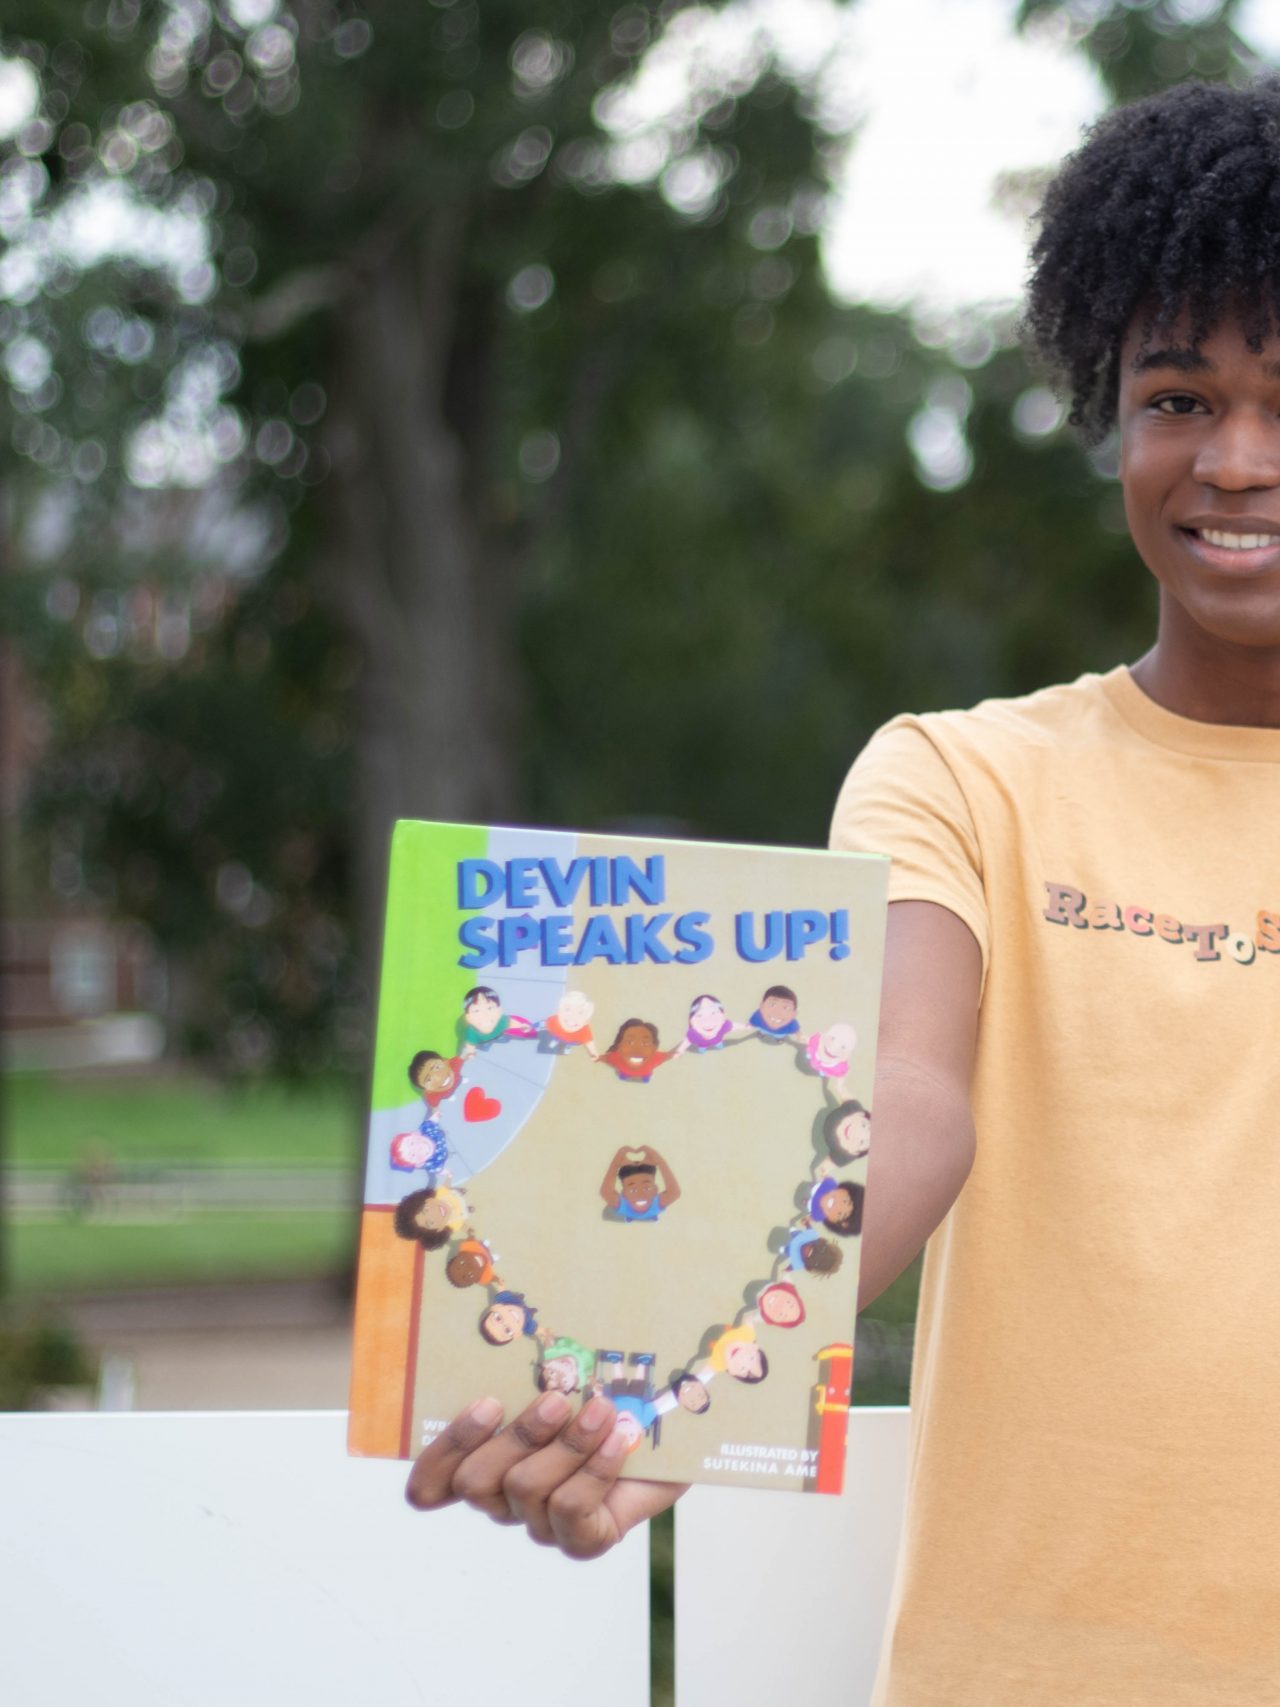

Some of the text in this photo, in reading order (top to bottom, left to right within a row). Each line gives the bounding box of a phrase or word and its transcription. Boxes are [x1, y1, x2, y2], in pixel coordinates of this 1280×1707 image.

[457, 855, 665, 910] DEVIN
[457, 909, 851, 969] SPEAKS UP!
[703, 1457, 817, 1477] SUTEKINA AME
[721, 1443, 818, 1462] ILLUSTRATED BY
